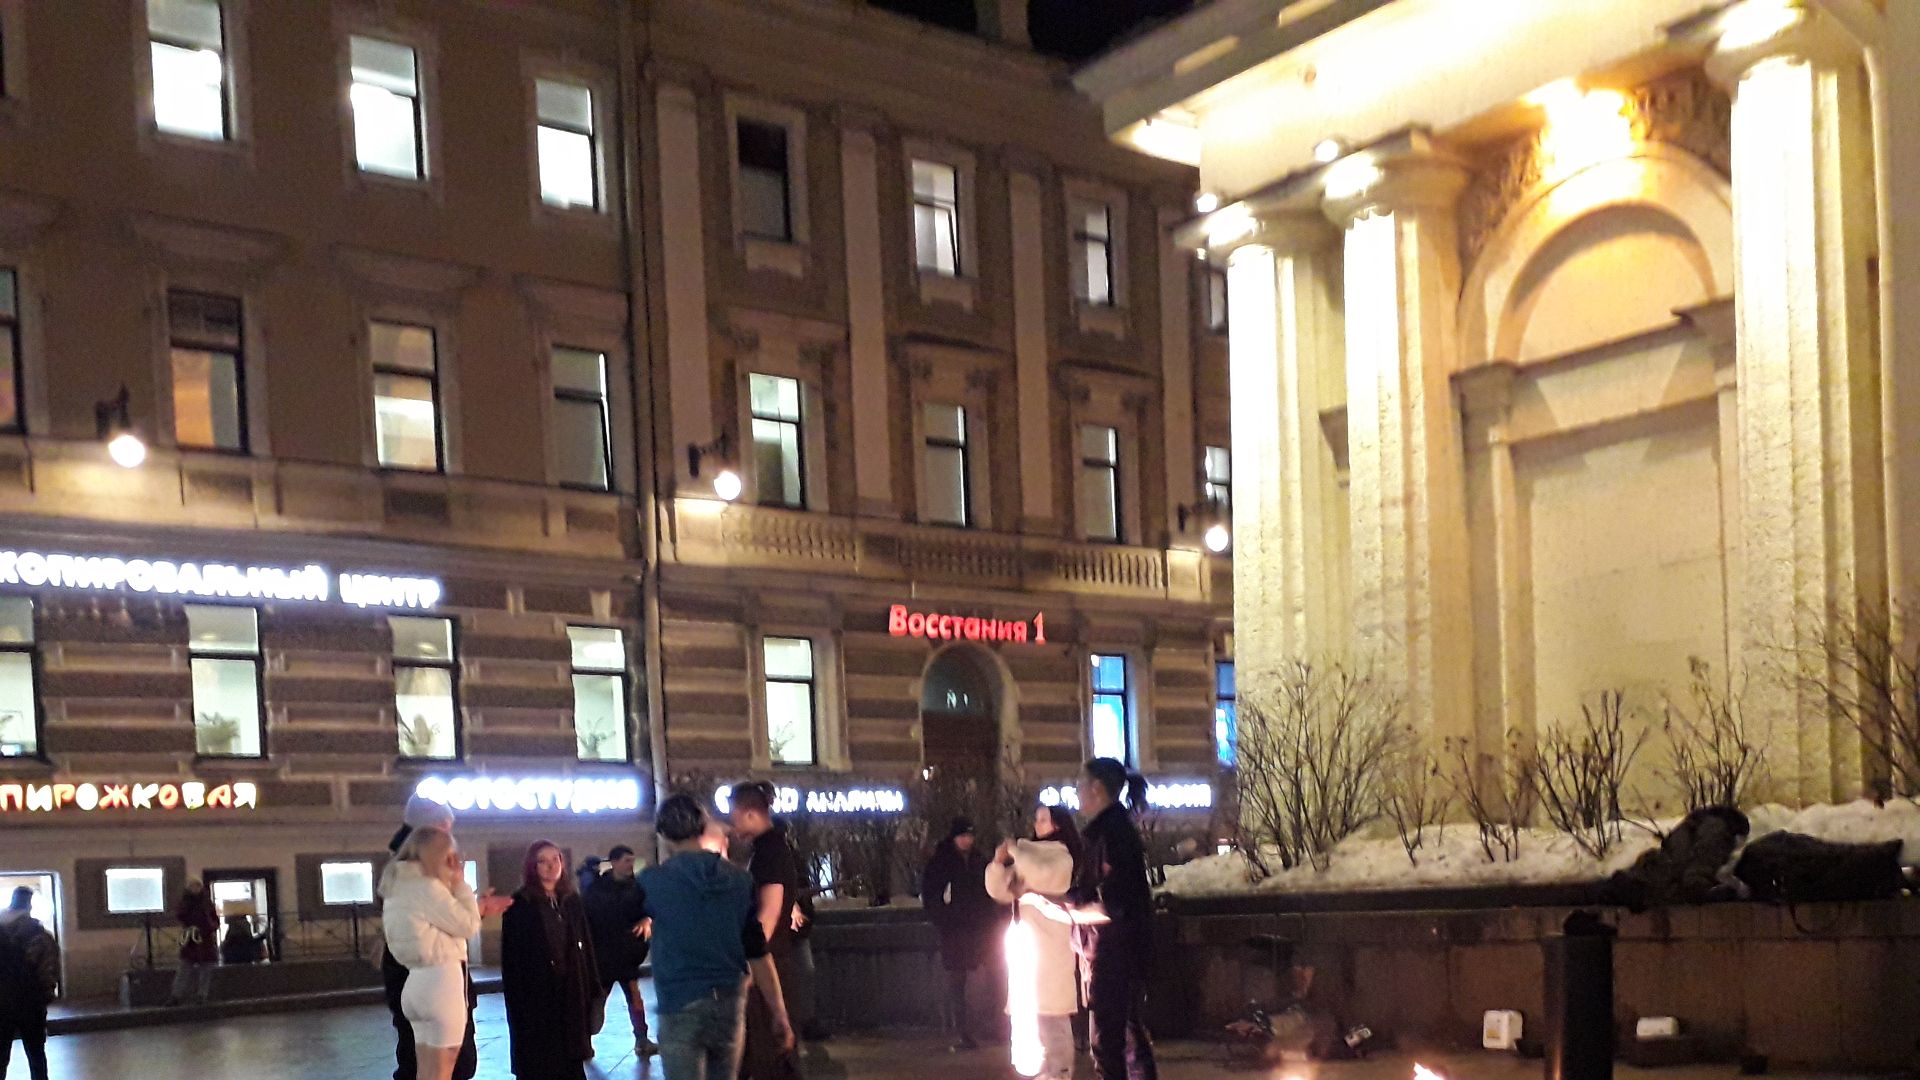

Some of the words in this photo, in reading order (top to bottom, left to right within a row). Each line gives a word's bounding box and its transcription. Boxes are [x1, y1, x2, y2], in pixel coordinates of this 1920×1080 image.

[339, 573, 440, 608] ЦЕНТР
[889, 604, 1027, 643] Восстания
[1033, 611, 1046, 645] 1
[0, 782, 257, 811] ПИРОЖКОВАЯ
